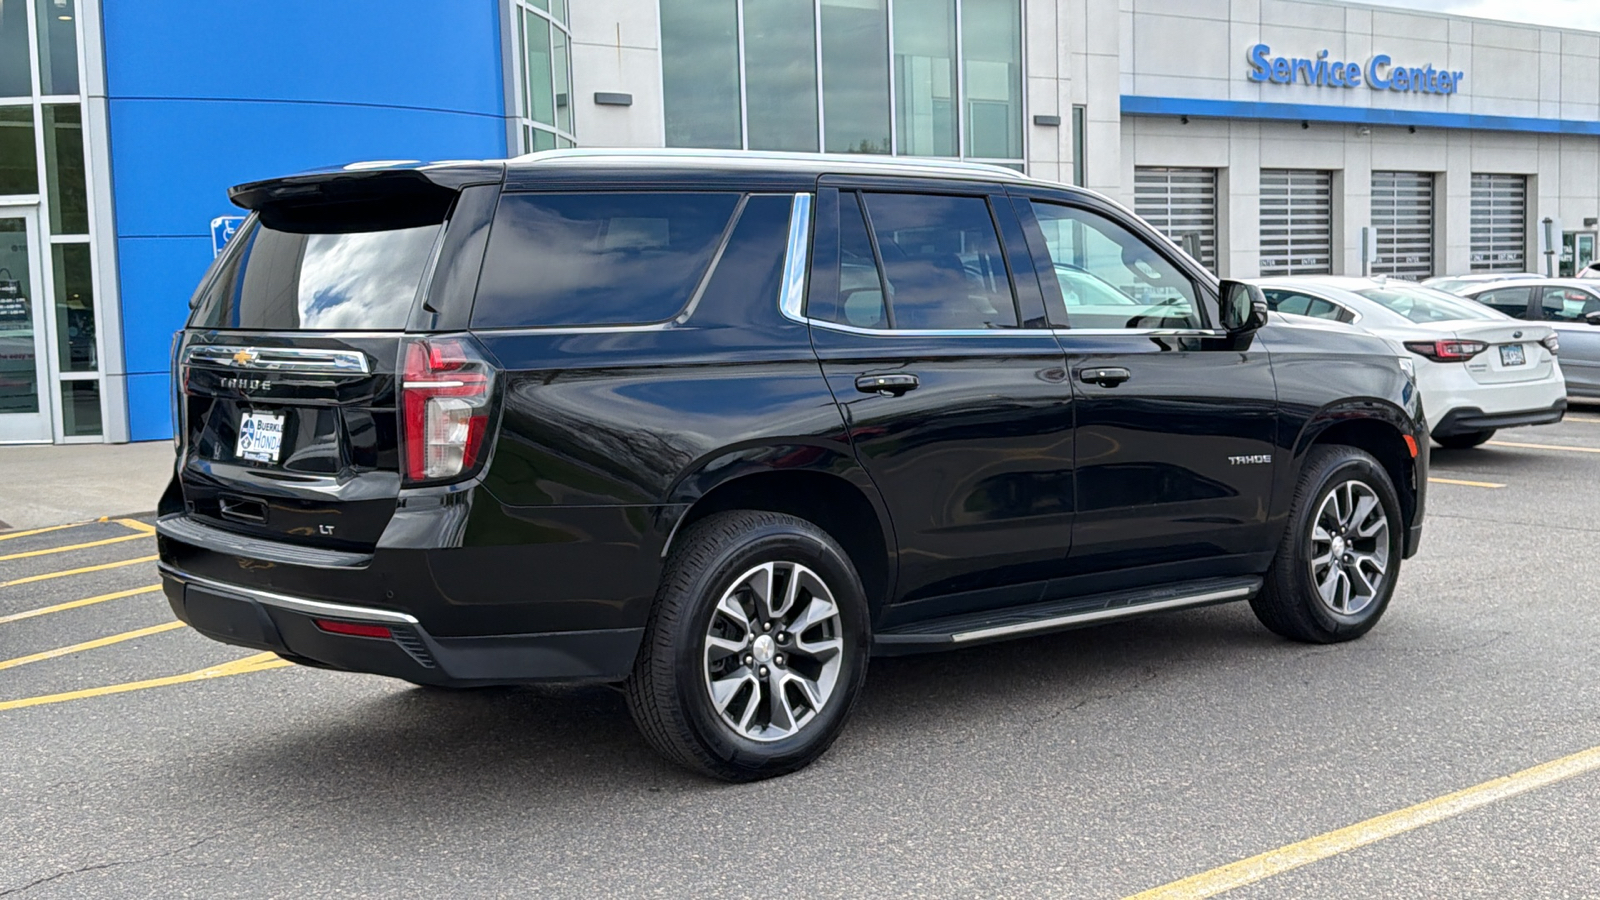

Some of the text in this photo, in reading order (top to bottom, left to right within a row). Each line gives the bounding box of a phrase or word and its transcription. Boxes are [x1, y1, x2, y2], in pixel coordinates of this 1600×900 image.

[1250, 44, 1464, 94] Service Center
[219, 377, 272, 391] TAHOE
[256, 419, 284, 433] BUERKLE
[254, 431, 281, 450] HONDA
[1227, 454, 1272, 465] TAHOE
[318, 524, 336, 535] LT
